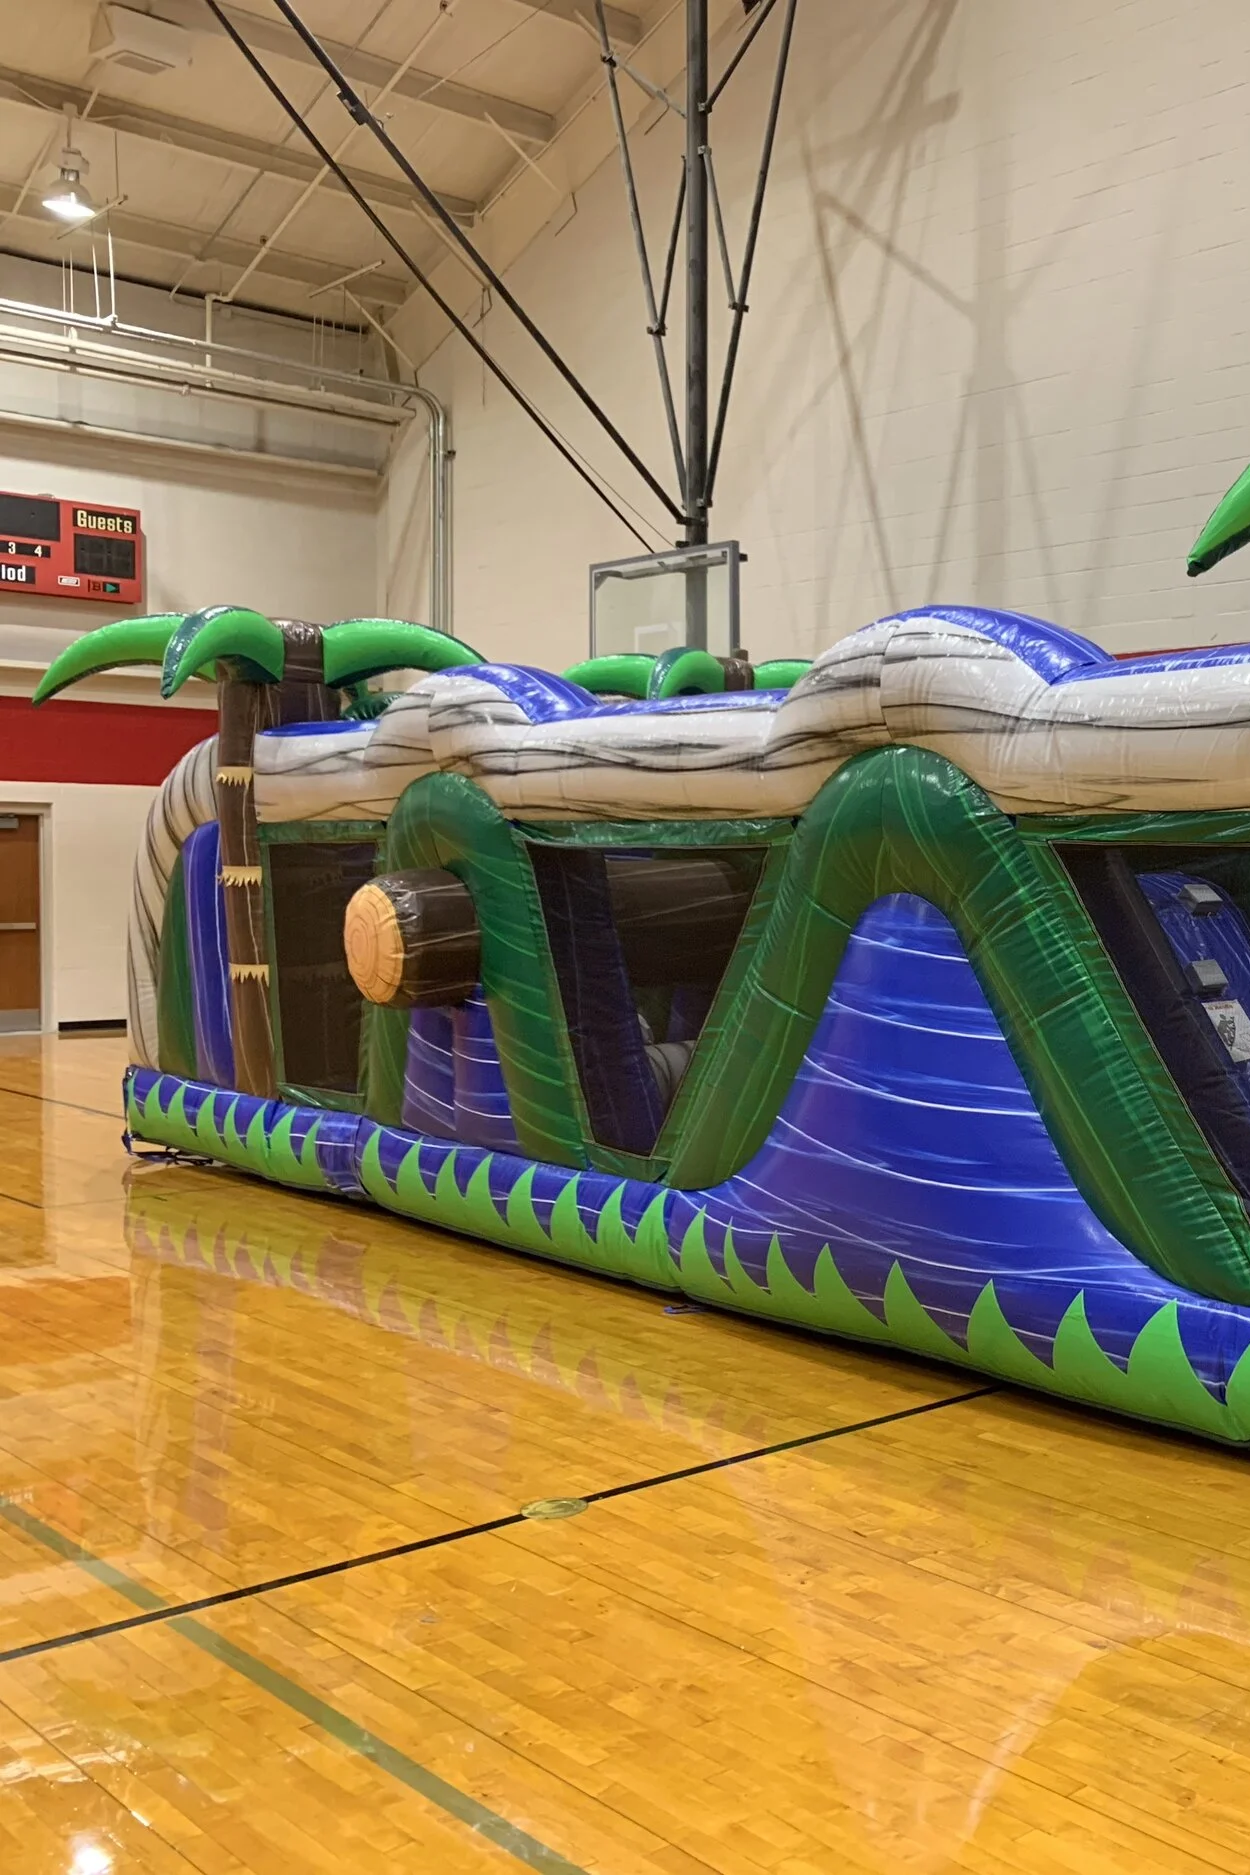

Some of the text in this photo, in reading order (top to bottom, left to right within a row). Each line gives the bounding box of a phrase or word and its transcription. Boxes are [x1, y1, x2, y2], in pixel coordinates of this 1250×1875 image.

[76, 509, 133, 534] Guests
[8, 541, 42, 558] 3 4
